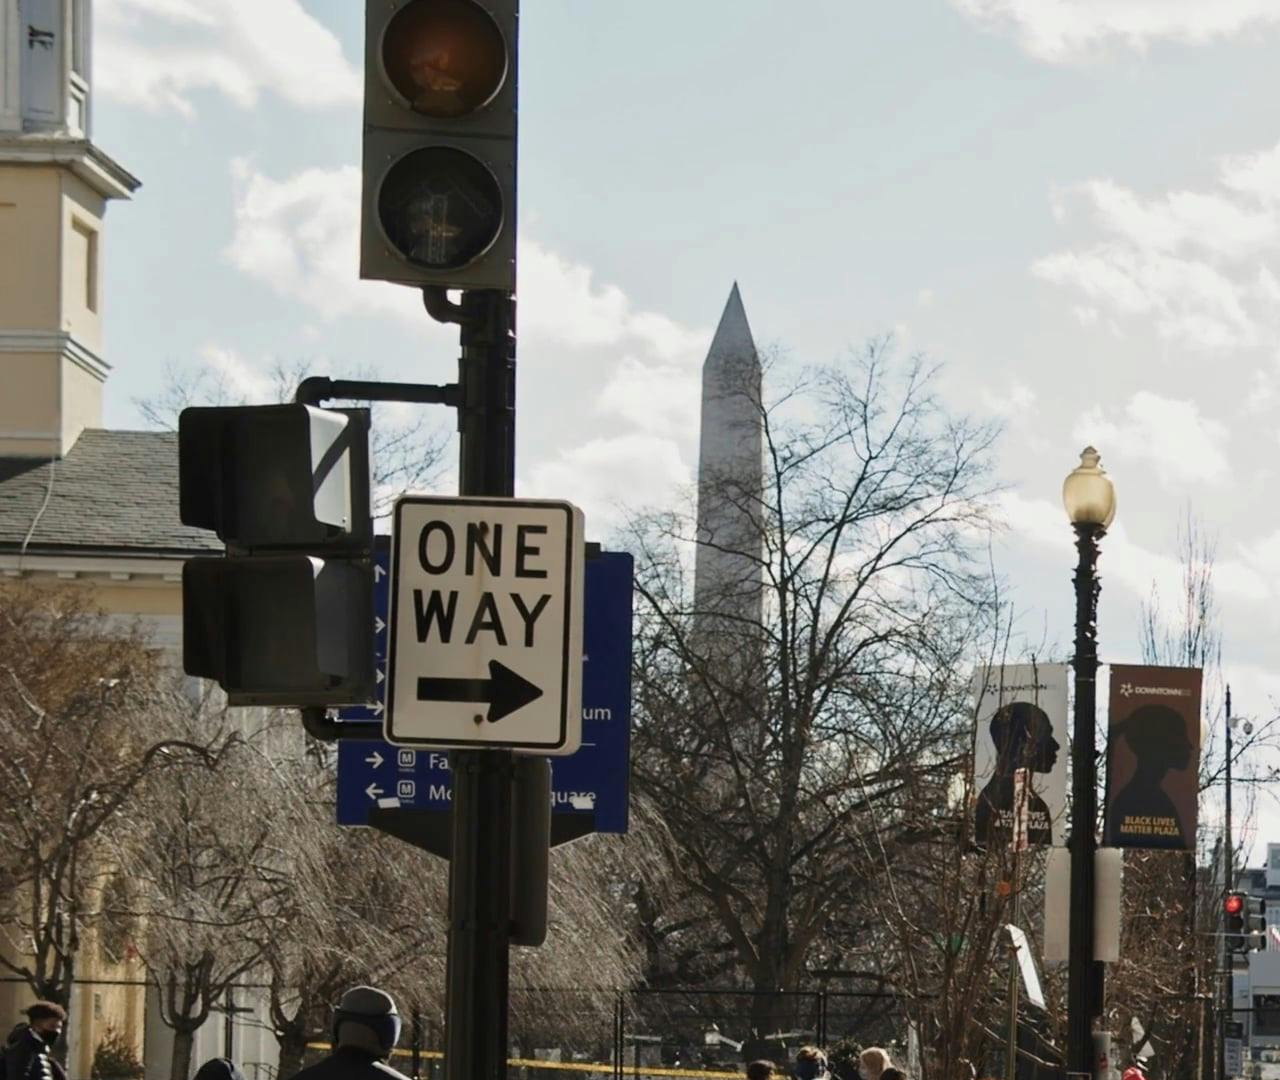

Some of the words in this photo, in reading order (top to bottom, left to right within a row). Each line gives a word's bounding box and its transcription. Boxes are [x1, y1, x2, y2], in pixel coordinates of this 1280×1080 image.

[418, 520, 549, 579] ONE
[413, 588, 552, 648] WAY
[1120, 825, 1151, 835] MATTER
[1153, 827, 1180, 836] PLAZA
[1124, 815, 1151, 827] BLACK
[1152, 816, 1176, 827] LIVES
